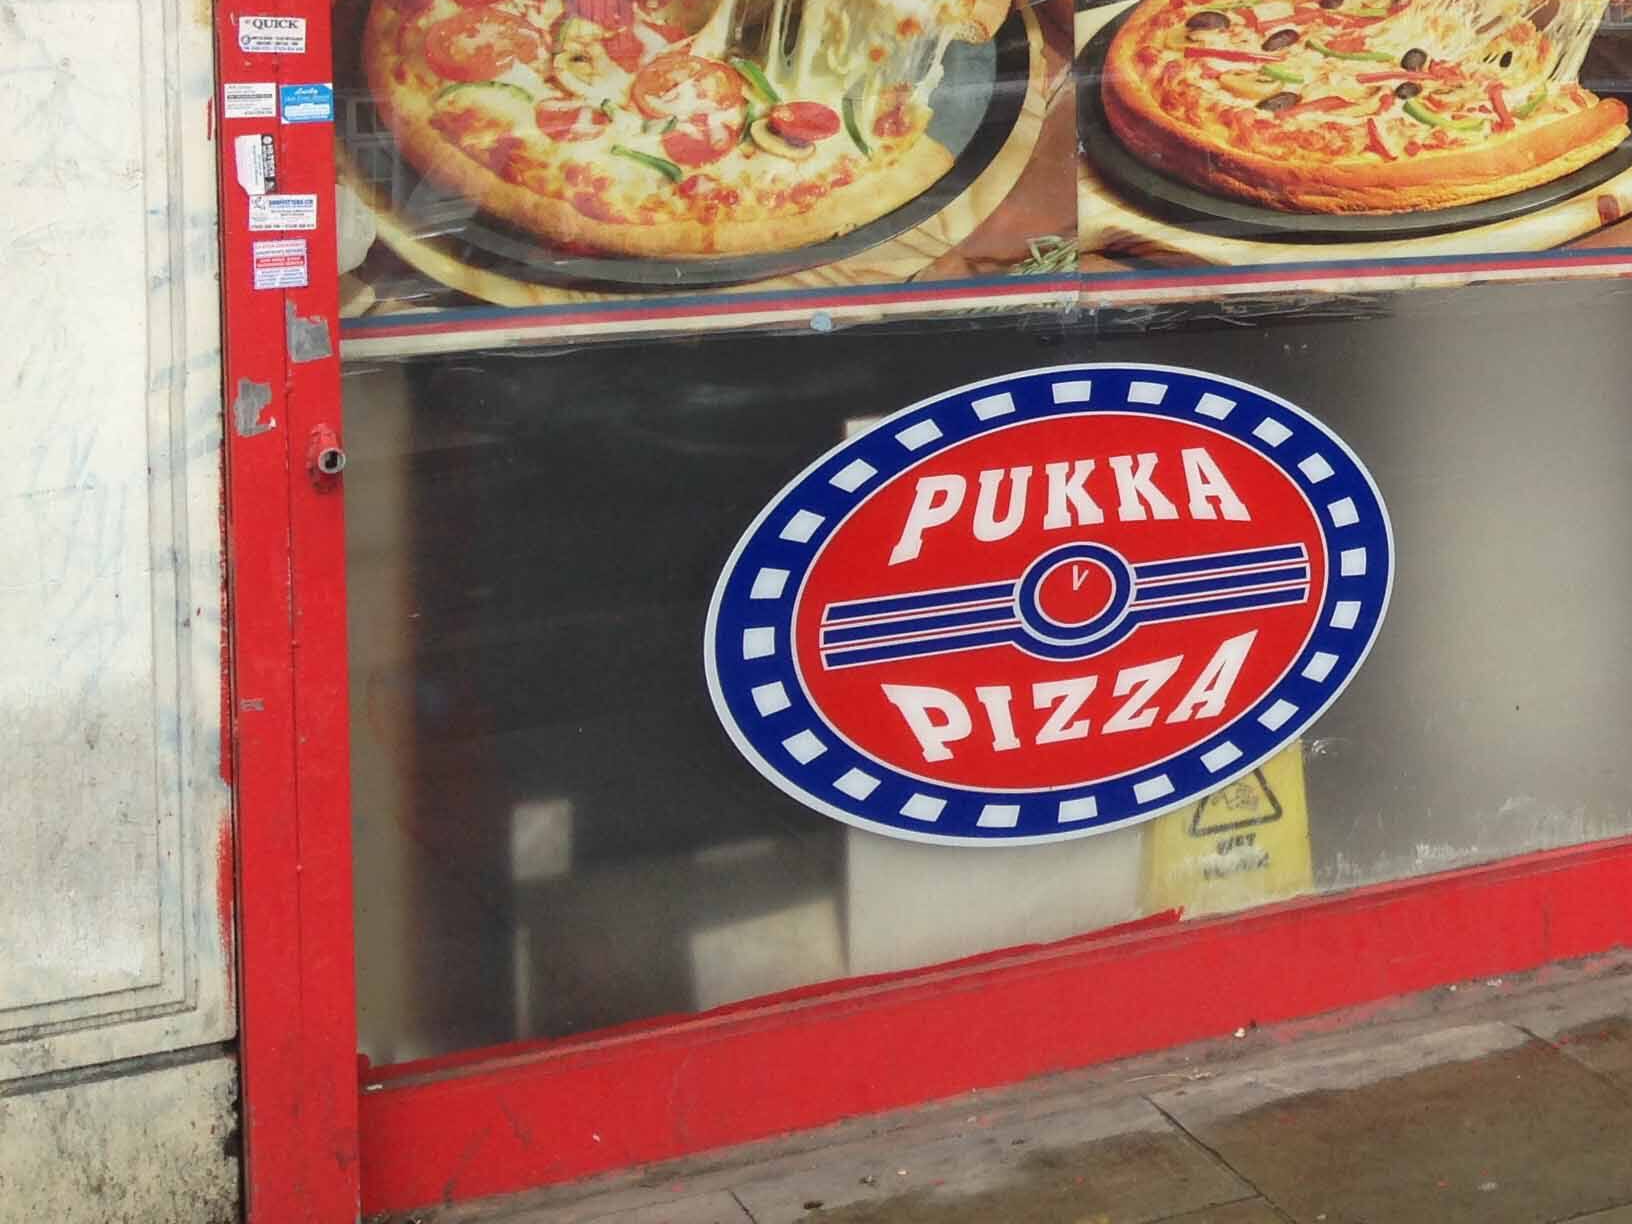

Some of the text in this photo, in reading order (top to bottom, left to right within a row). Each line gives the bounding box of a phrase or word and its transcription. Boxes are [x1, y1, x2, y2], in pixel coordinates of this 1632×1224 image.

[252, 18, 298, 30] QUICK
[888, 447, 1251, 566] PUKKA
[881, 629, 1258, 763] PIZZA
